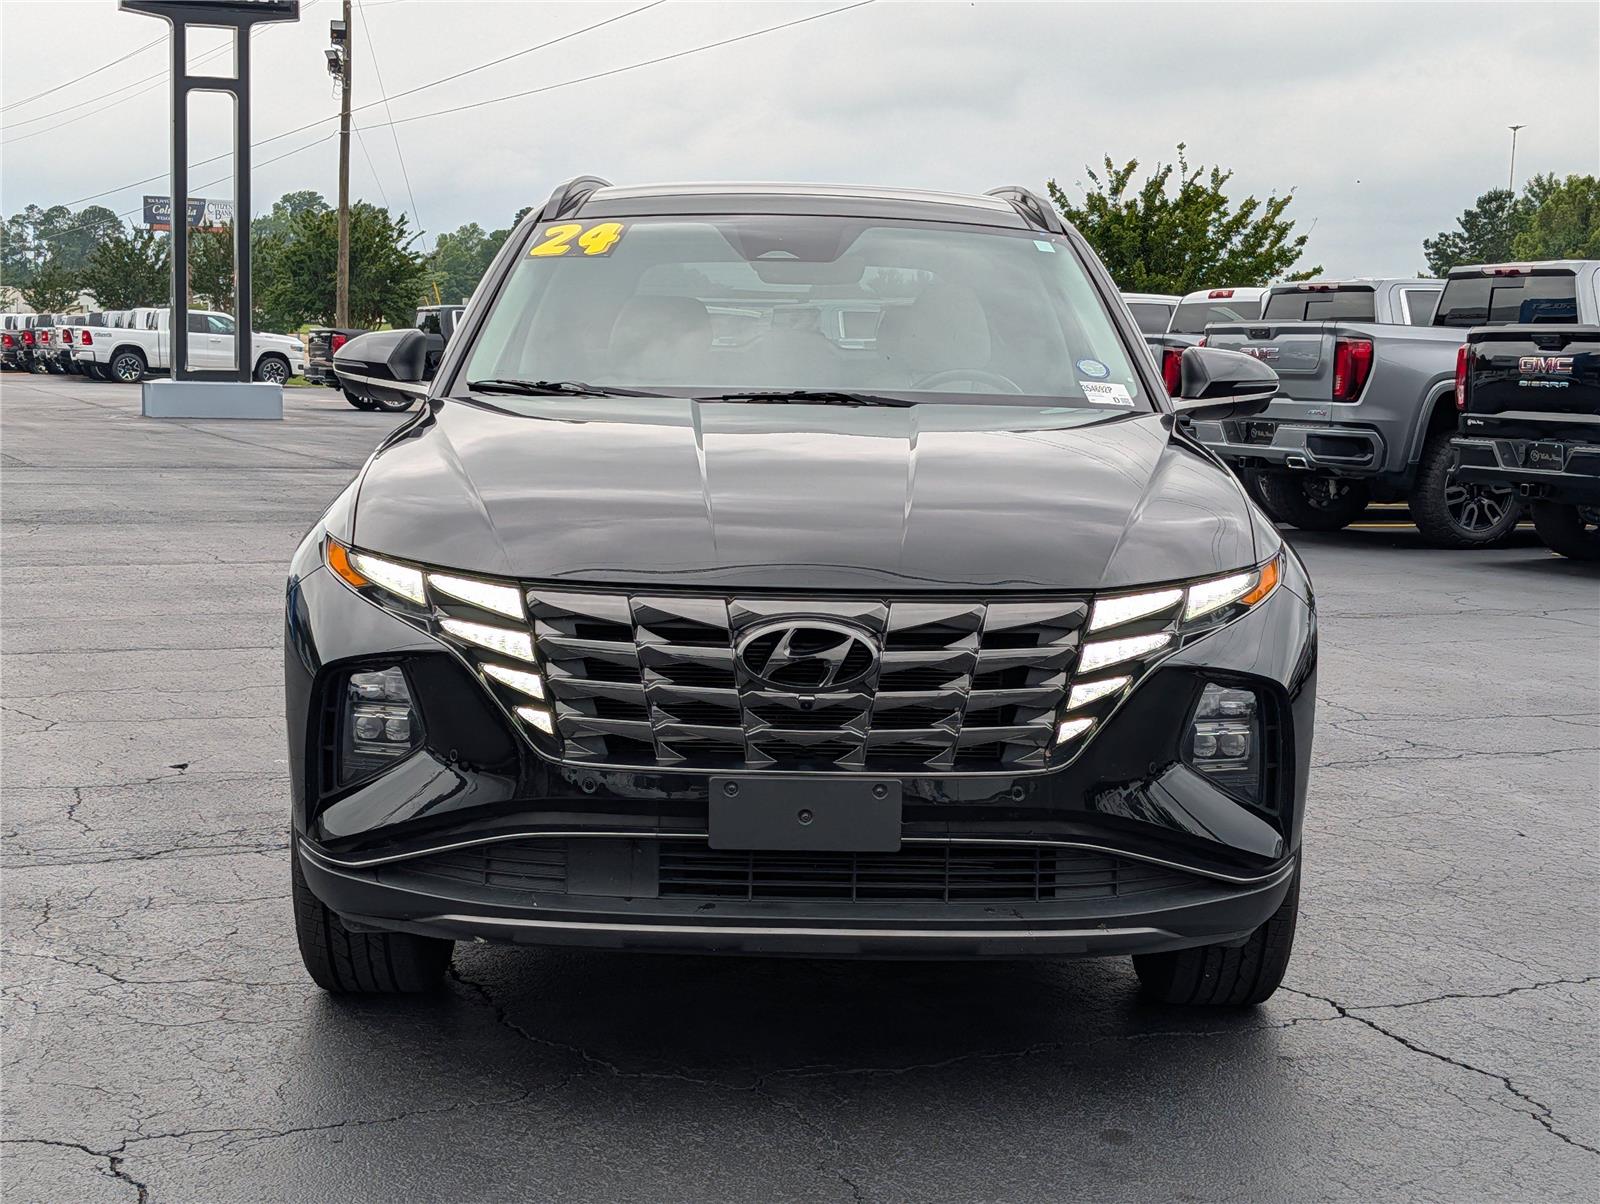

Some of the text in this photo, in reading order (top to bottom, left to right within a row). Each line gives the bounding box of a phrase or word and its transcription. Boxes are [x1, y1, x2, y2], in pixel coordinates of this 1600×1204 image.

[152, 204, 197, 216] Colia
[529, 222, 624, 256] 24
[1519, 357, 1574, 375] GMC
